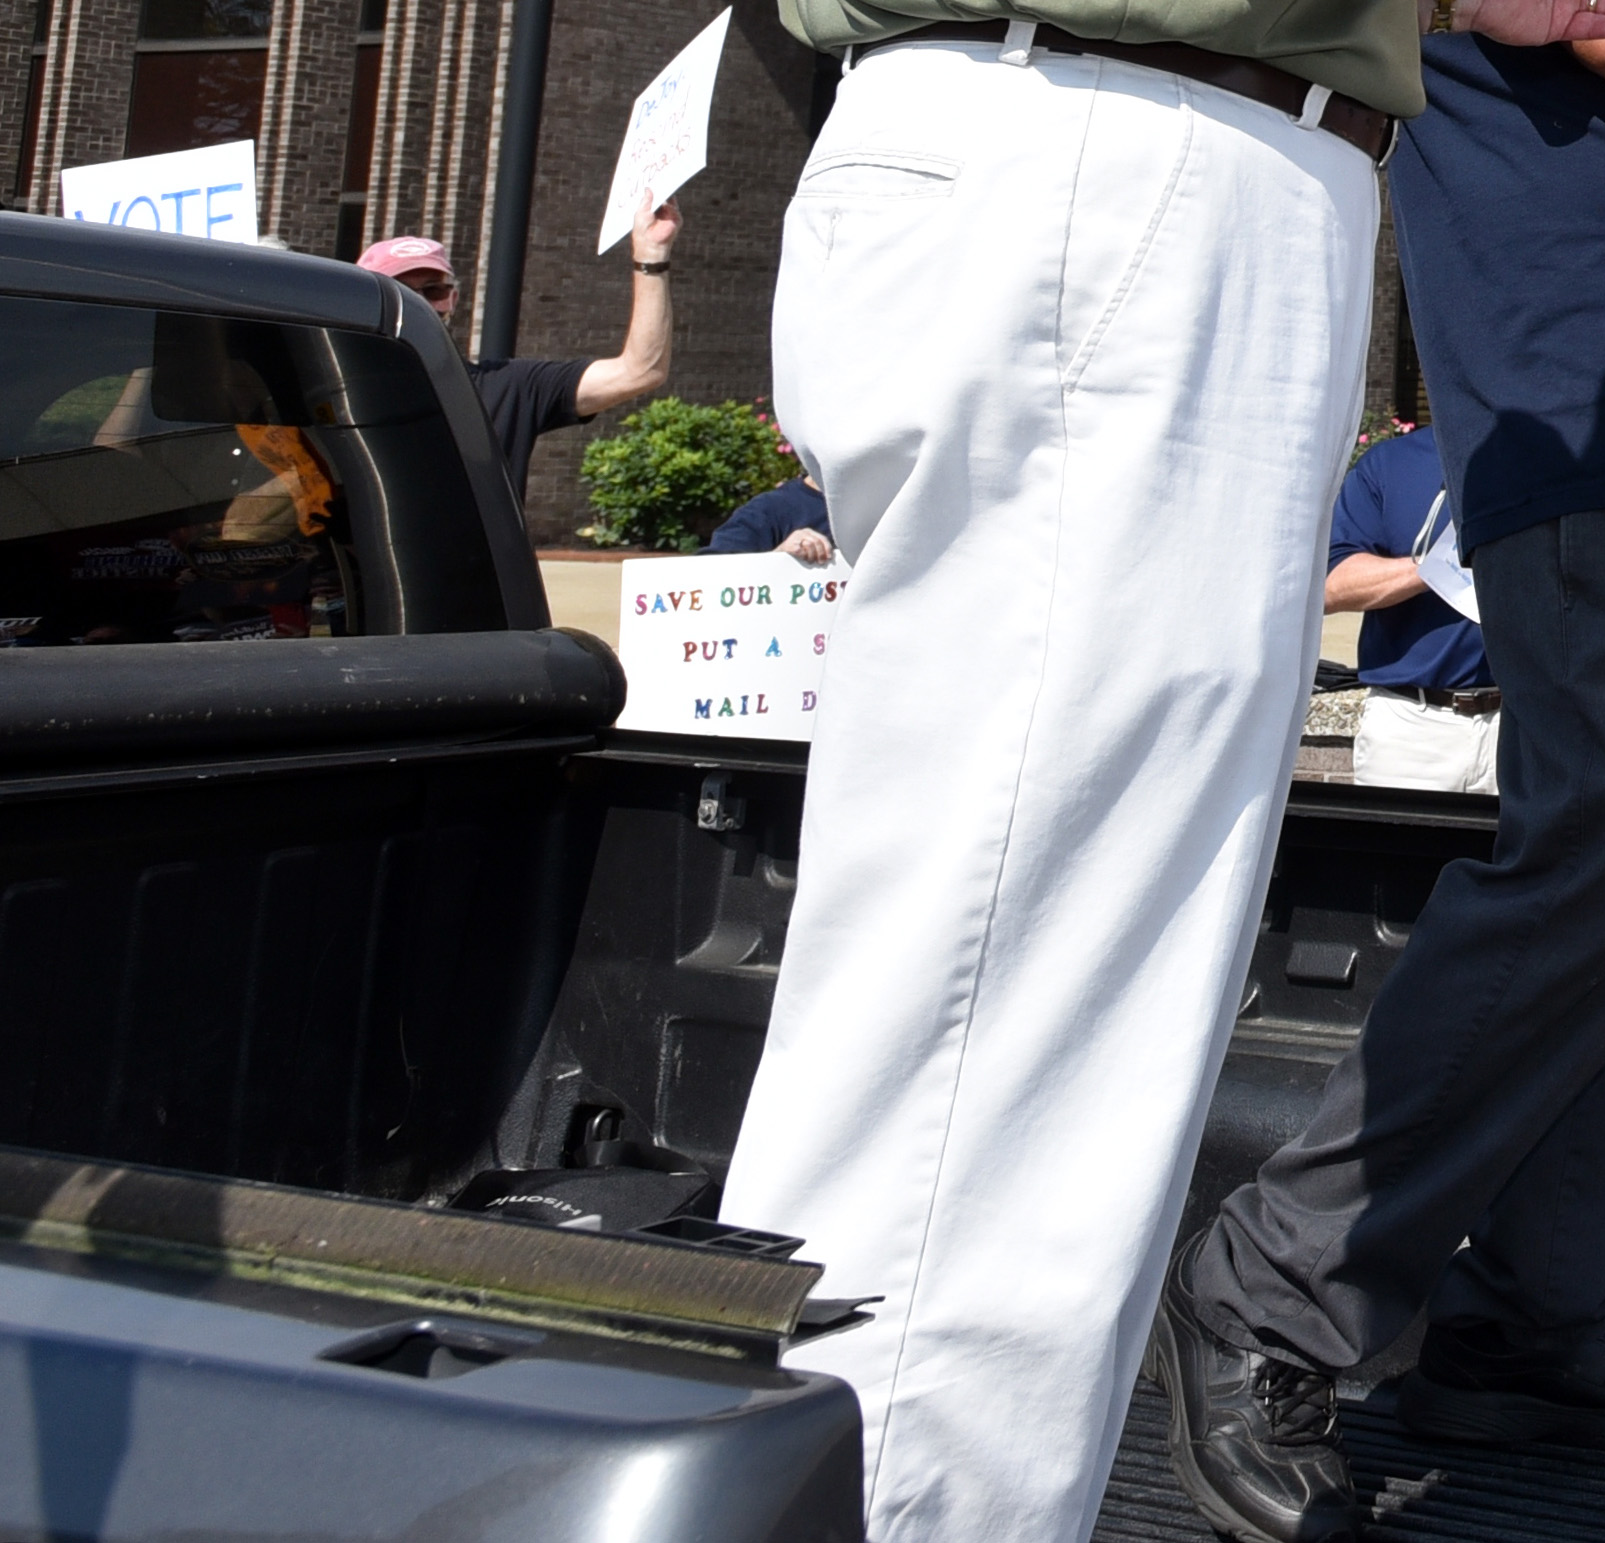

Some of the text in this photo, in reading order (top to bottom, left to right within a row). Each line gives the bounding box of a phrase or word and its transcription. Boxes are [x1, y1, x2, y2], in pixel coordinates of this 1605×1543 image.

[635, 581, 848, 616] SAVE OUR POS
[683, 638, 738, 662] PUT
[765, 636, 783, 657] A
[695, 694, 769, 719] MAIL
